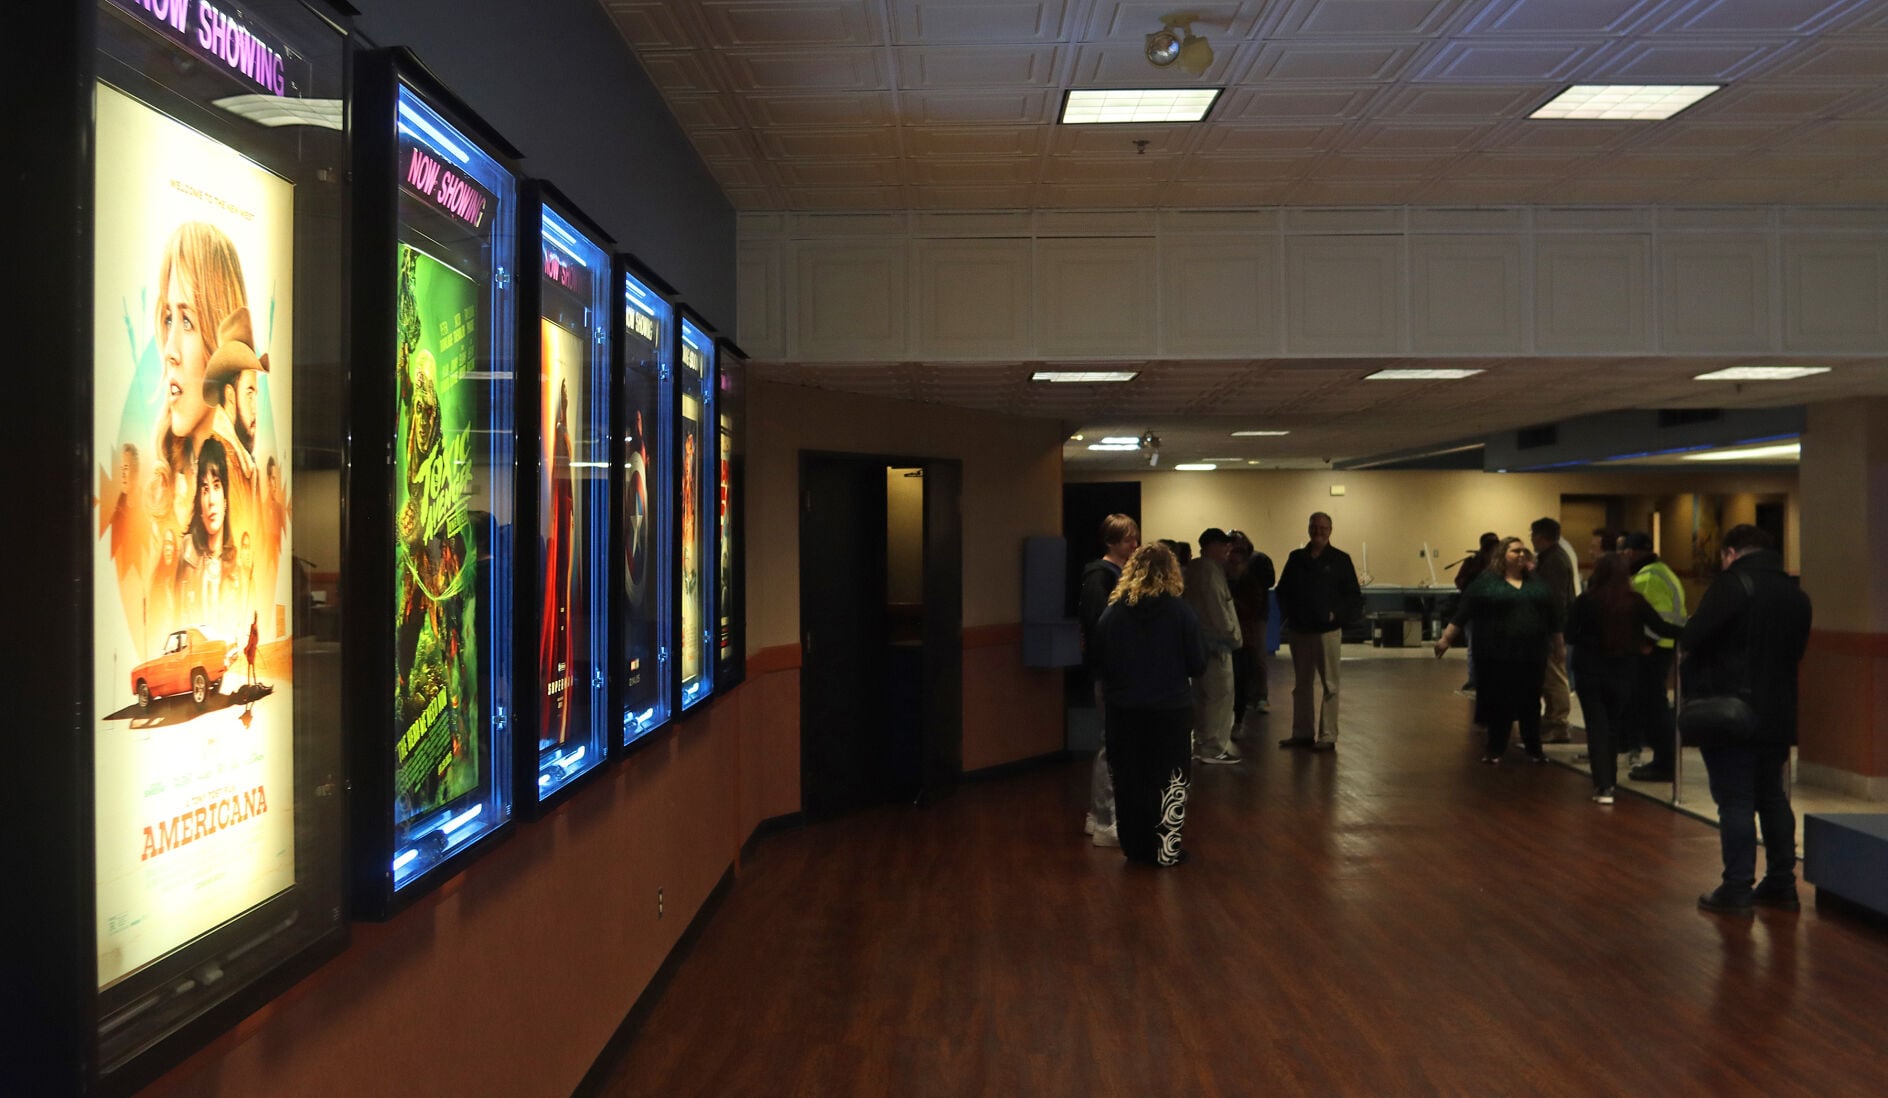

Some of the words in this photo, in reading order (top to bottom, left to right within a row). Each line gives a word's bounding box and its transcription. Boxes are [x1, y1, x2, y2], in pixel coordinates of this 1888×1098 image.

[135, 0, 188, 34] OW
[198, 2, 285, 97] SHOWING
[408, 147, 441, 196] NOW
[437, 170, 487, 228] SHOWING
[412, 420, 471, 528] TOXIC
[141, 785, 268, 862] AMERICANA
